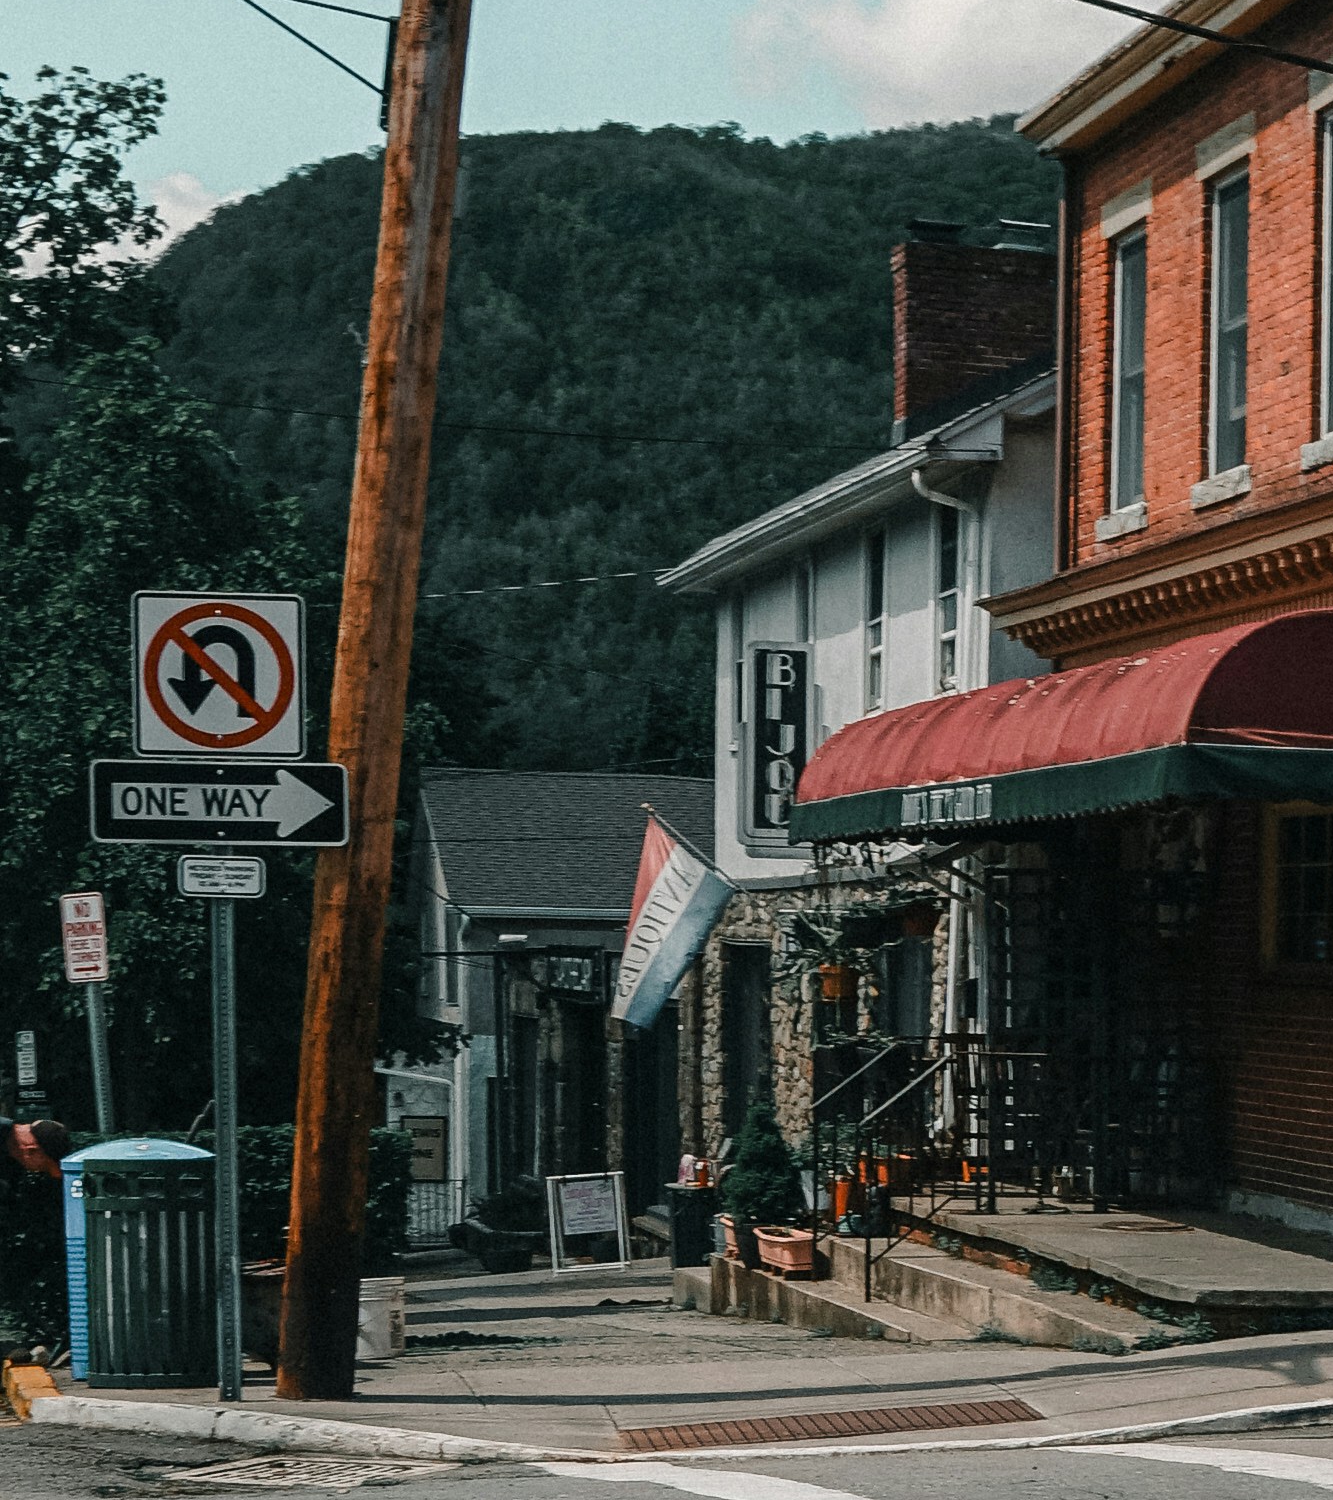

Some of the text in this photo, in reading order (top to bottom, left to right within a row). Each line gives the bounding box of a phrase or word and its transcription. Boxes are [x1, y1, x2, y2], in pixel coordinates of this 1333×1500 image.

[764, 652, 798, 826] BIJOU
[120, 786, 272, 818] ONE WAY
